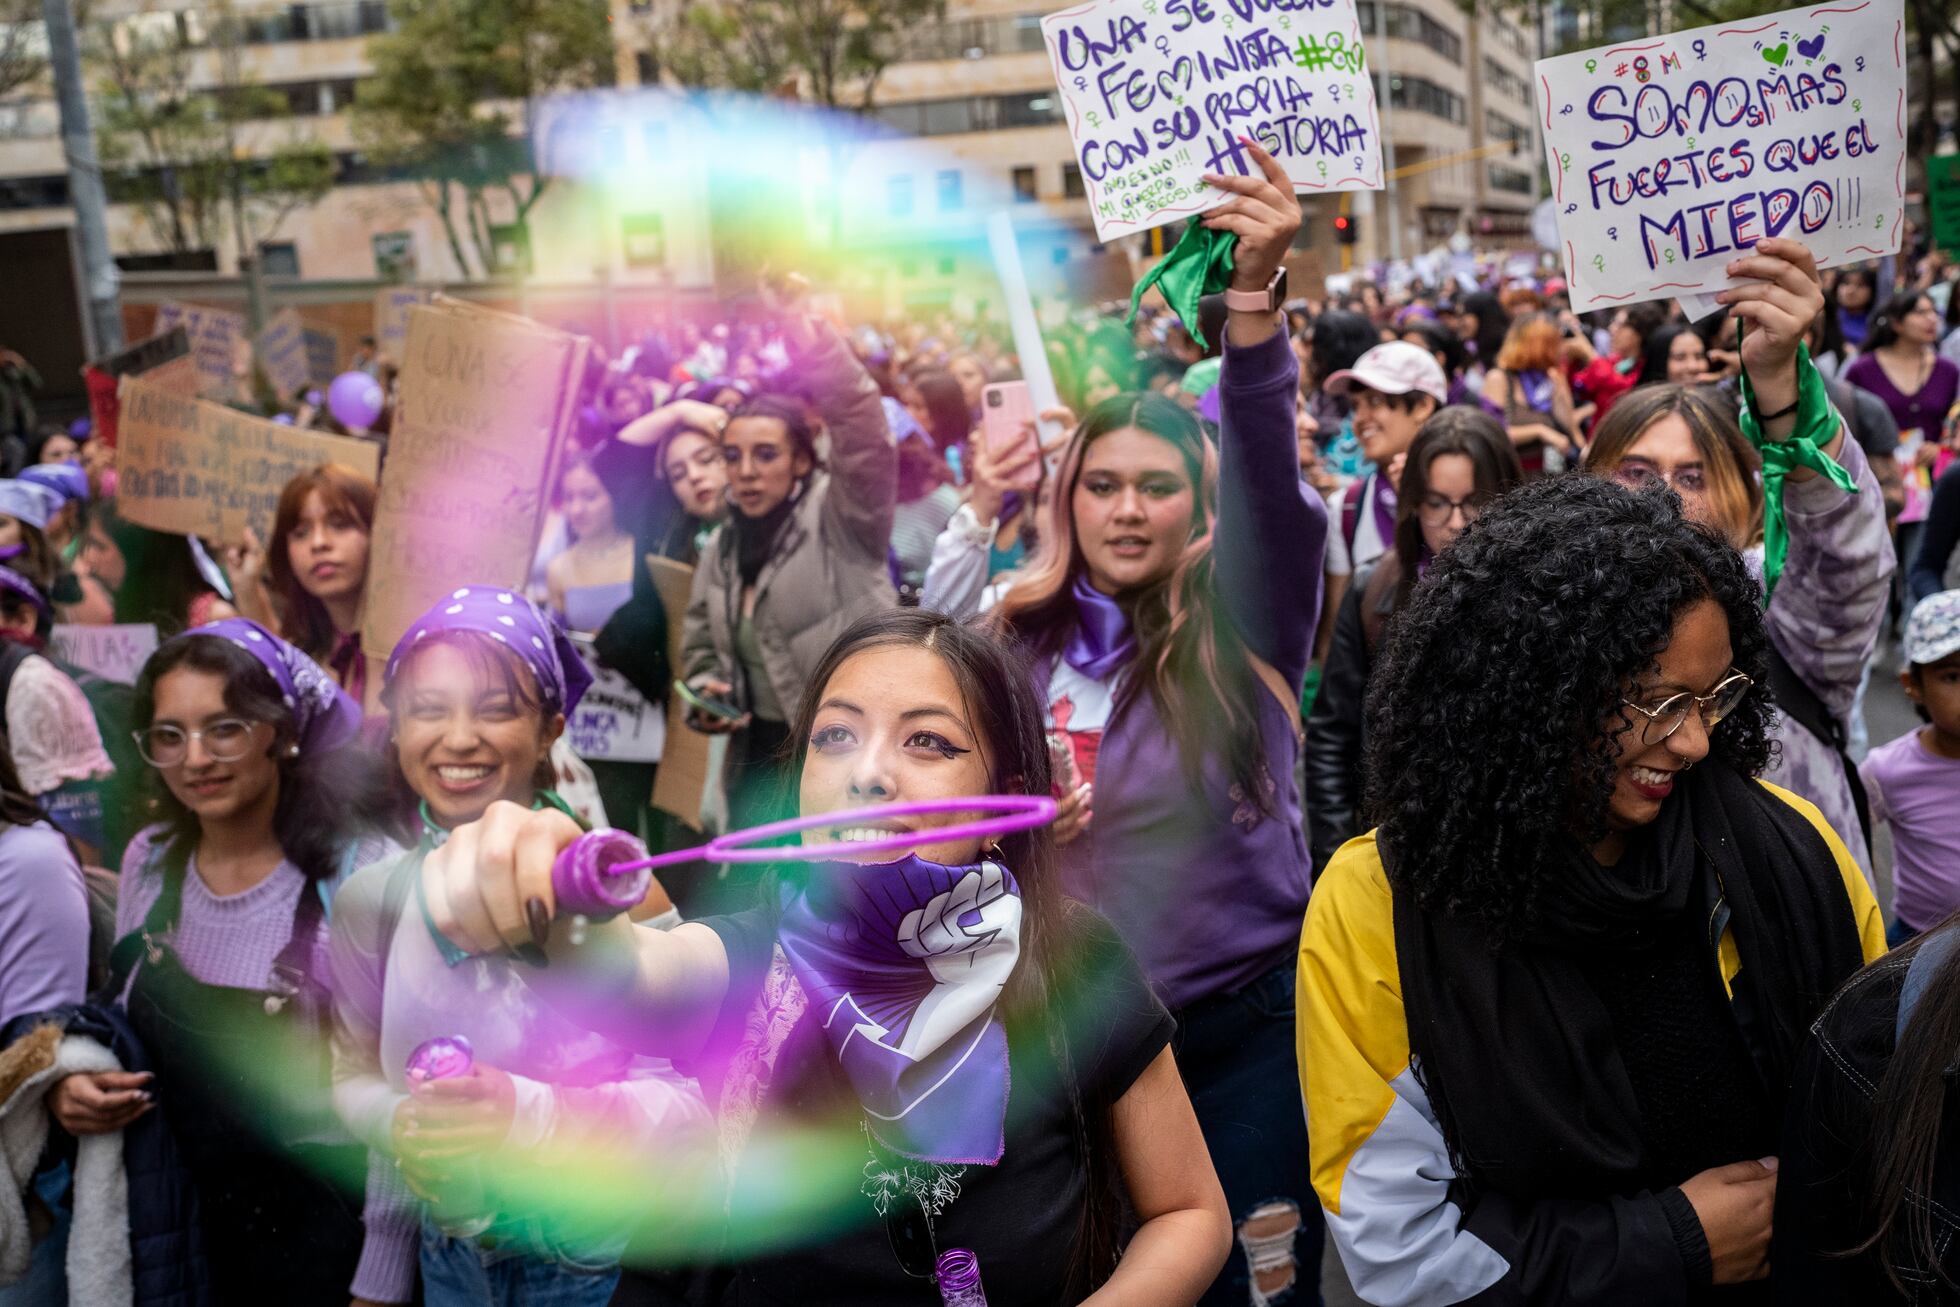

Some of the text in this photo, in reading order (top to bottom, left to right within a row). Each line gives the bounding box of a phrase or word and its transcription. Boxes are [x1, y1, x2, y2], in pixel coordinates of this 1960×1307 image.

[1059, 16, 1147, 71] UNA
[1097, 28, 1294, 120] FEMINISTA
[1756, 63, 1847, 126] MAS
[1082, 76, 1313, 181] CON SU PROPIA
[1205, 114, 1367, 176] HISTORIA
[1588, 139, 1754, 210] FUERTES
[1764, 131, 1840, 172] QUE
[1098, 201, 1117, 218] MI
